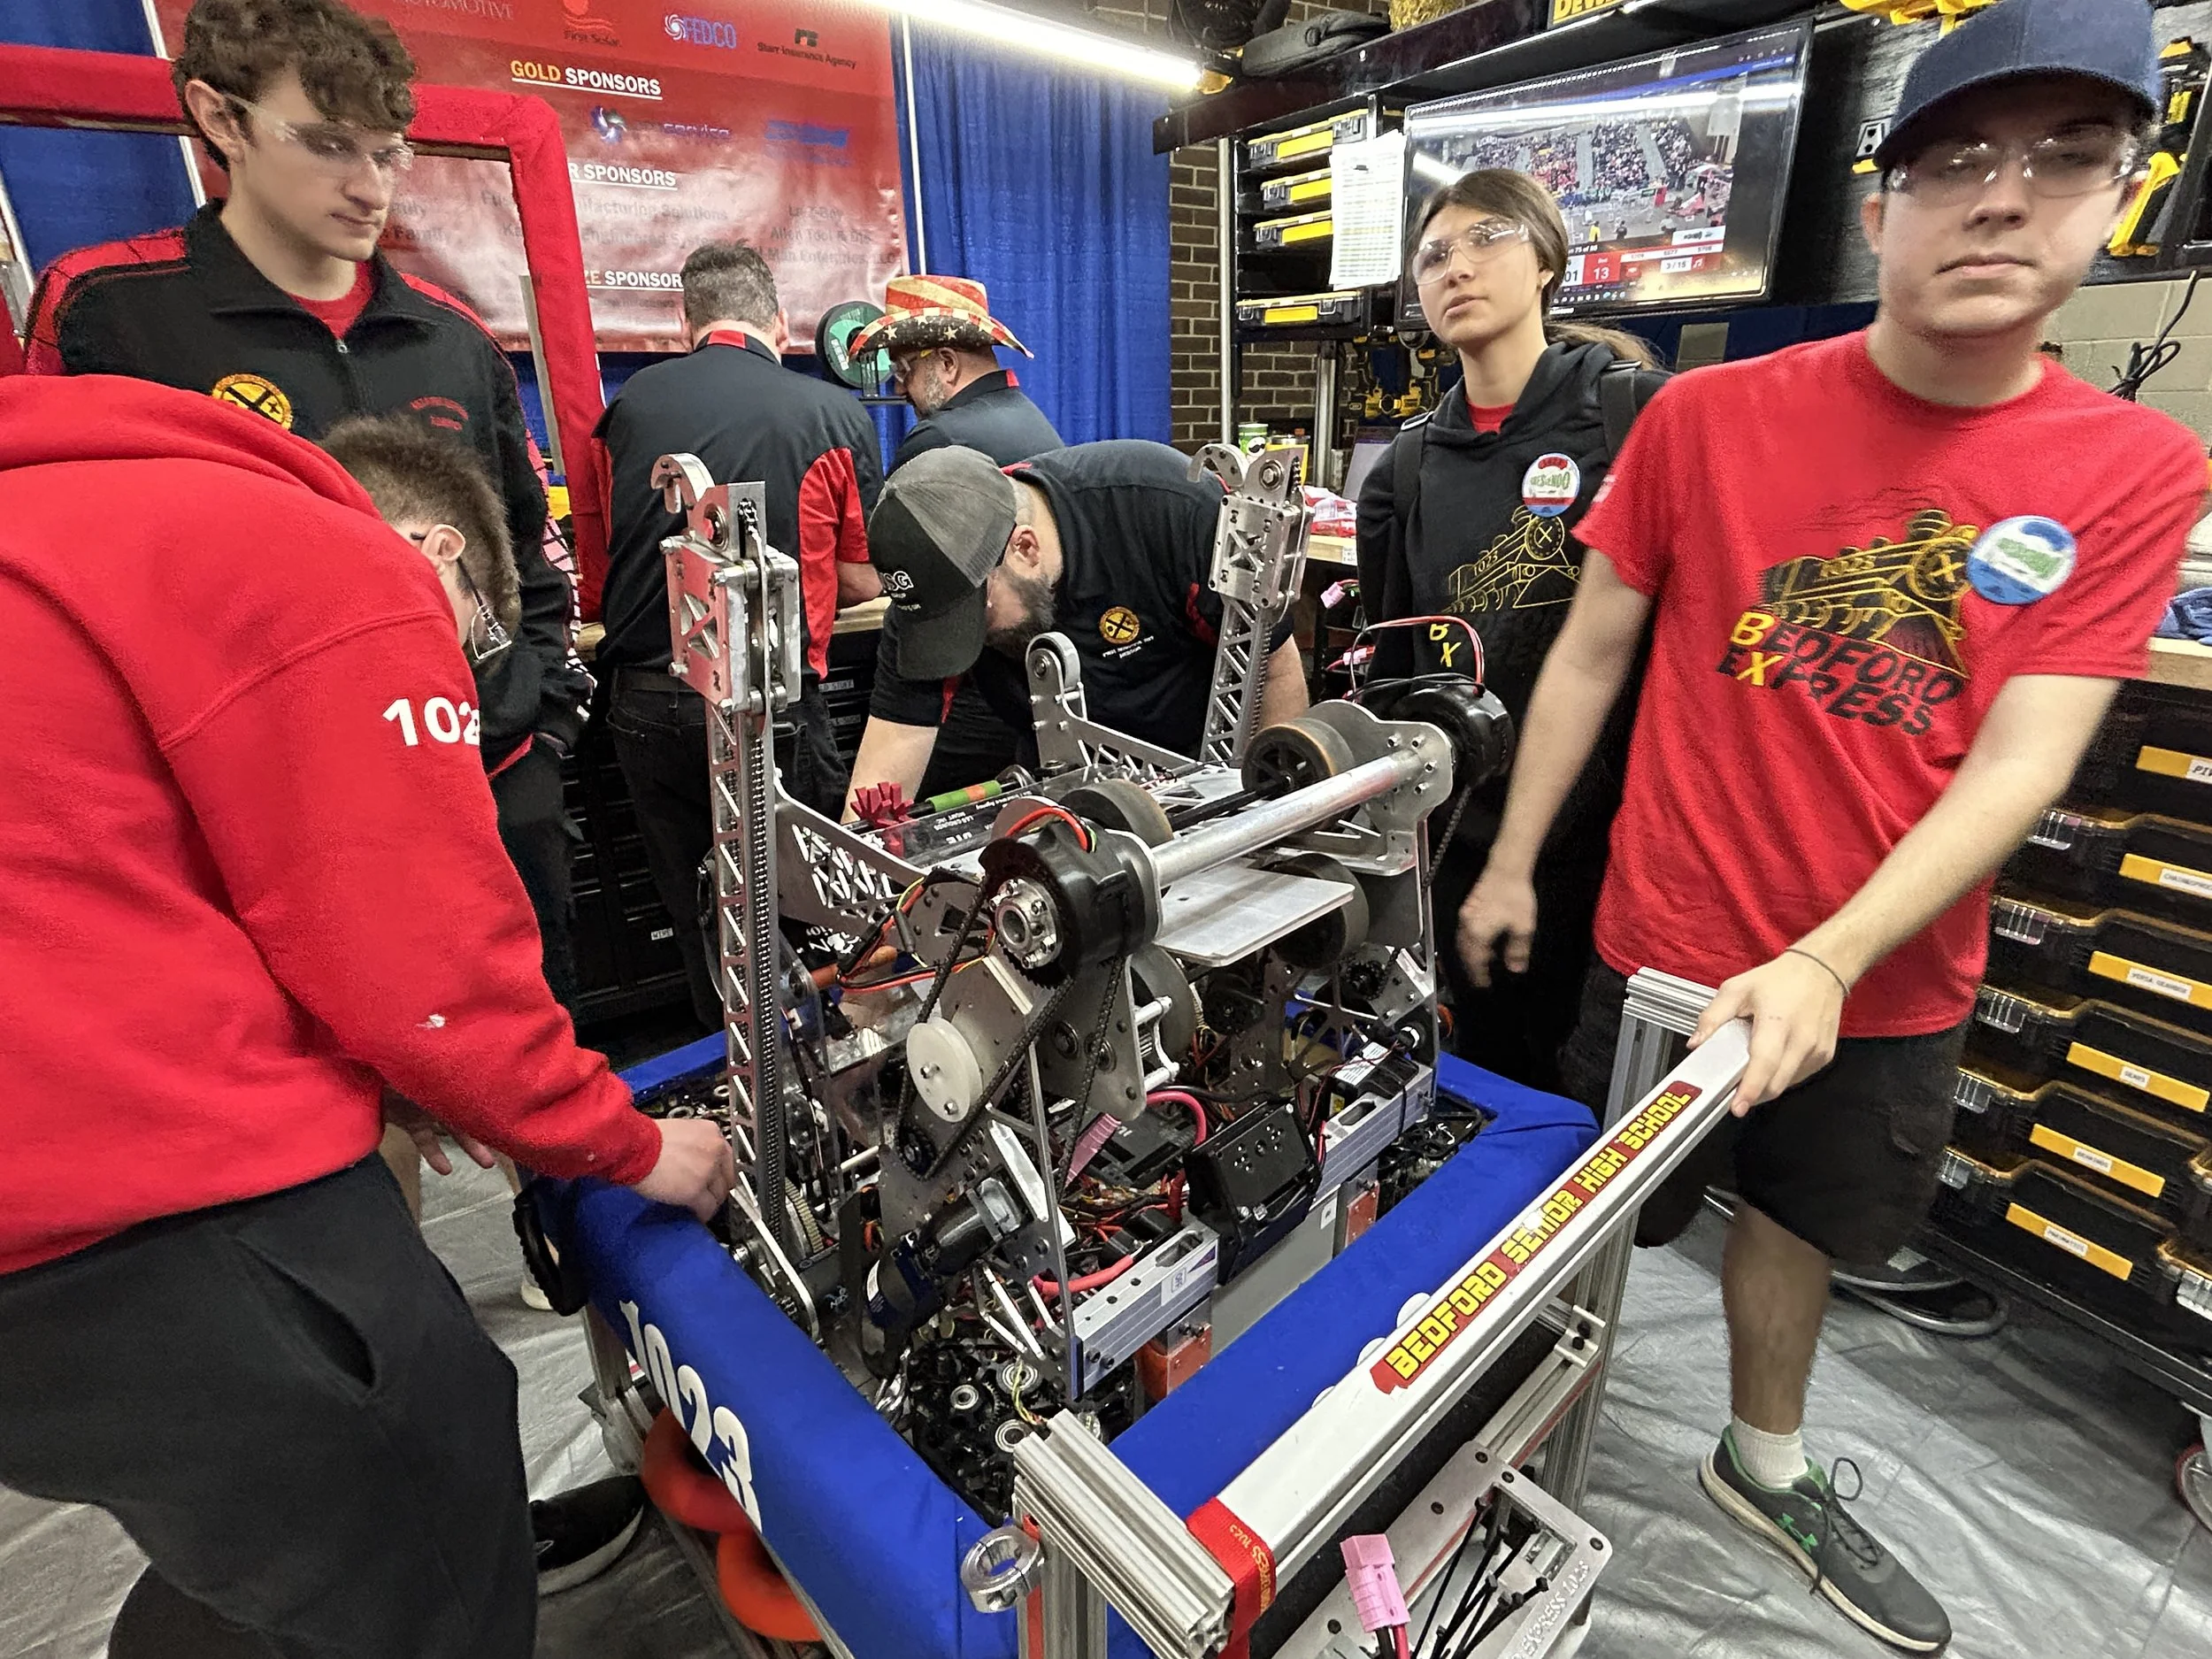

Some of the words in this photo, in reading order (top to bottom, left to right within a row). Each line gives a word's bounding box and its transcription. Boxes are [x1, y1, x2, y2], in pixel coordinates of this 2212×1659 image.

[682, 17, 737, 49] FEDCO
[511, 59, 561, 81] GOLD
[565, 67, 661, 96] SPONSORS
[825, 54, 856, 69] Agency
[584, 164, 676, 187] SPONSORS
[605, 270, 685, 288] SPONSOR
[1594, 266, 1609, 280] 13
[1473, 550, 1499, 576] 1023
[1731, 611, 1970, 706] BEDFORD
[1716, 647, 1934, 736] EXPRESS
[1384, 1261, 1508, 1379] BEDFORD
[1500, 1189, 1585, 1264] SENIOR
[1573, 1147, 1628, 1193] HIGH
[1617, 1091, 1692, 1151] SCHOOL
[619, 1300, 763, 1534] 1023
